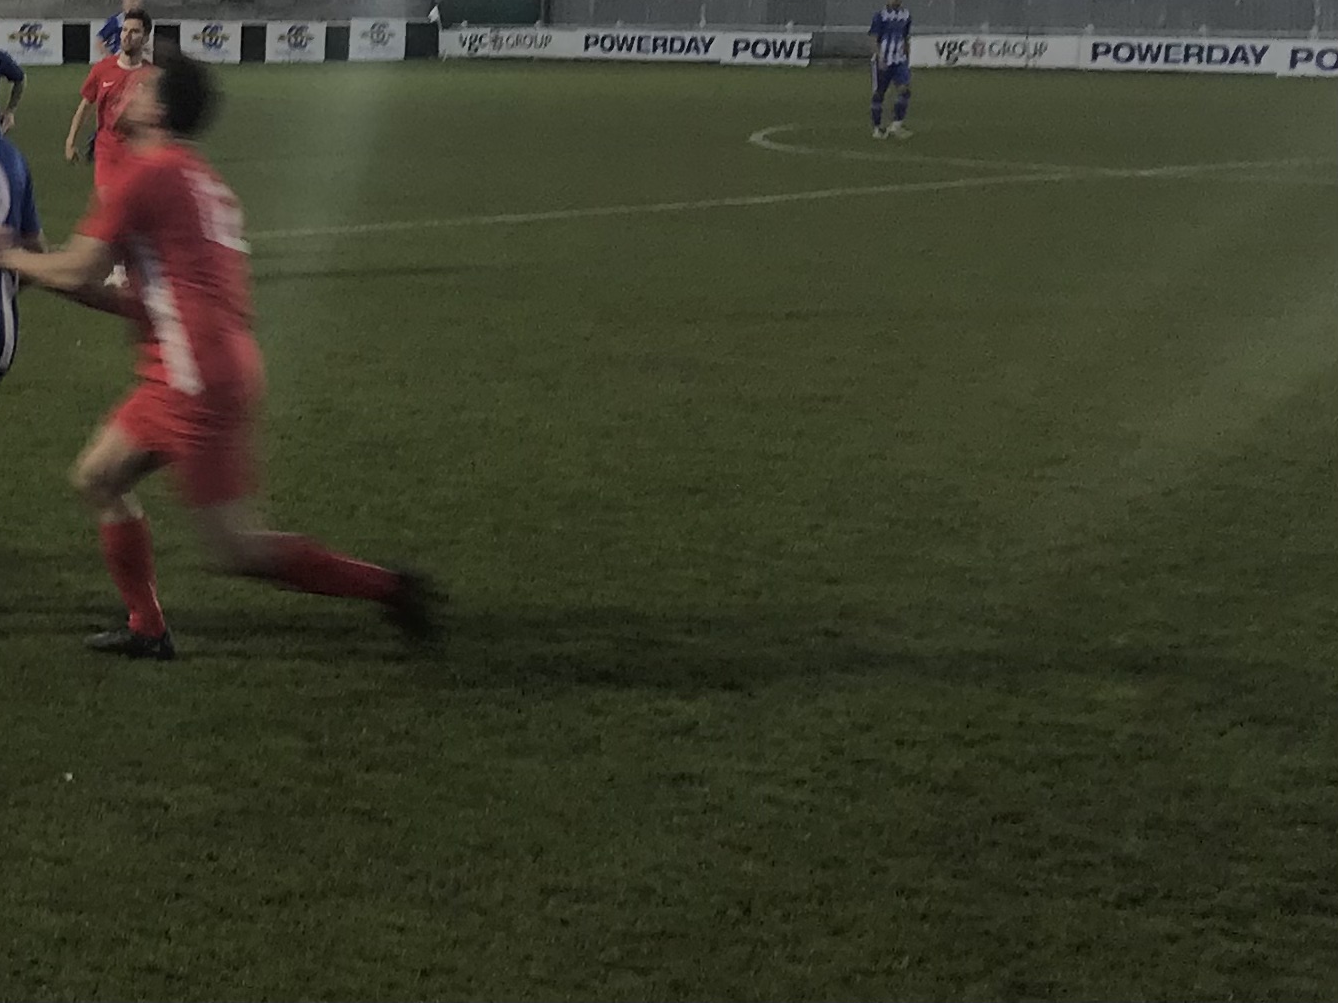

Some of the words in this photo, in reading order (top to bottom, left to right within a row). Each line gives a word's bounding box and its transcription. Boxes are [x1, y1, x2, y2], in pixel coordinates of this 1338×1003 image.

[505, 33, 552, 49] GROUP
[584, 34, 717, 55] POWERDAY
[988, 40, 1048, 59] GROUP
[1091, 42, 1270, 66] POWERDAY
[1289, 46, 1338, 70] PO
